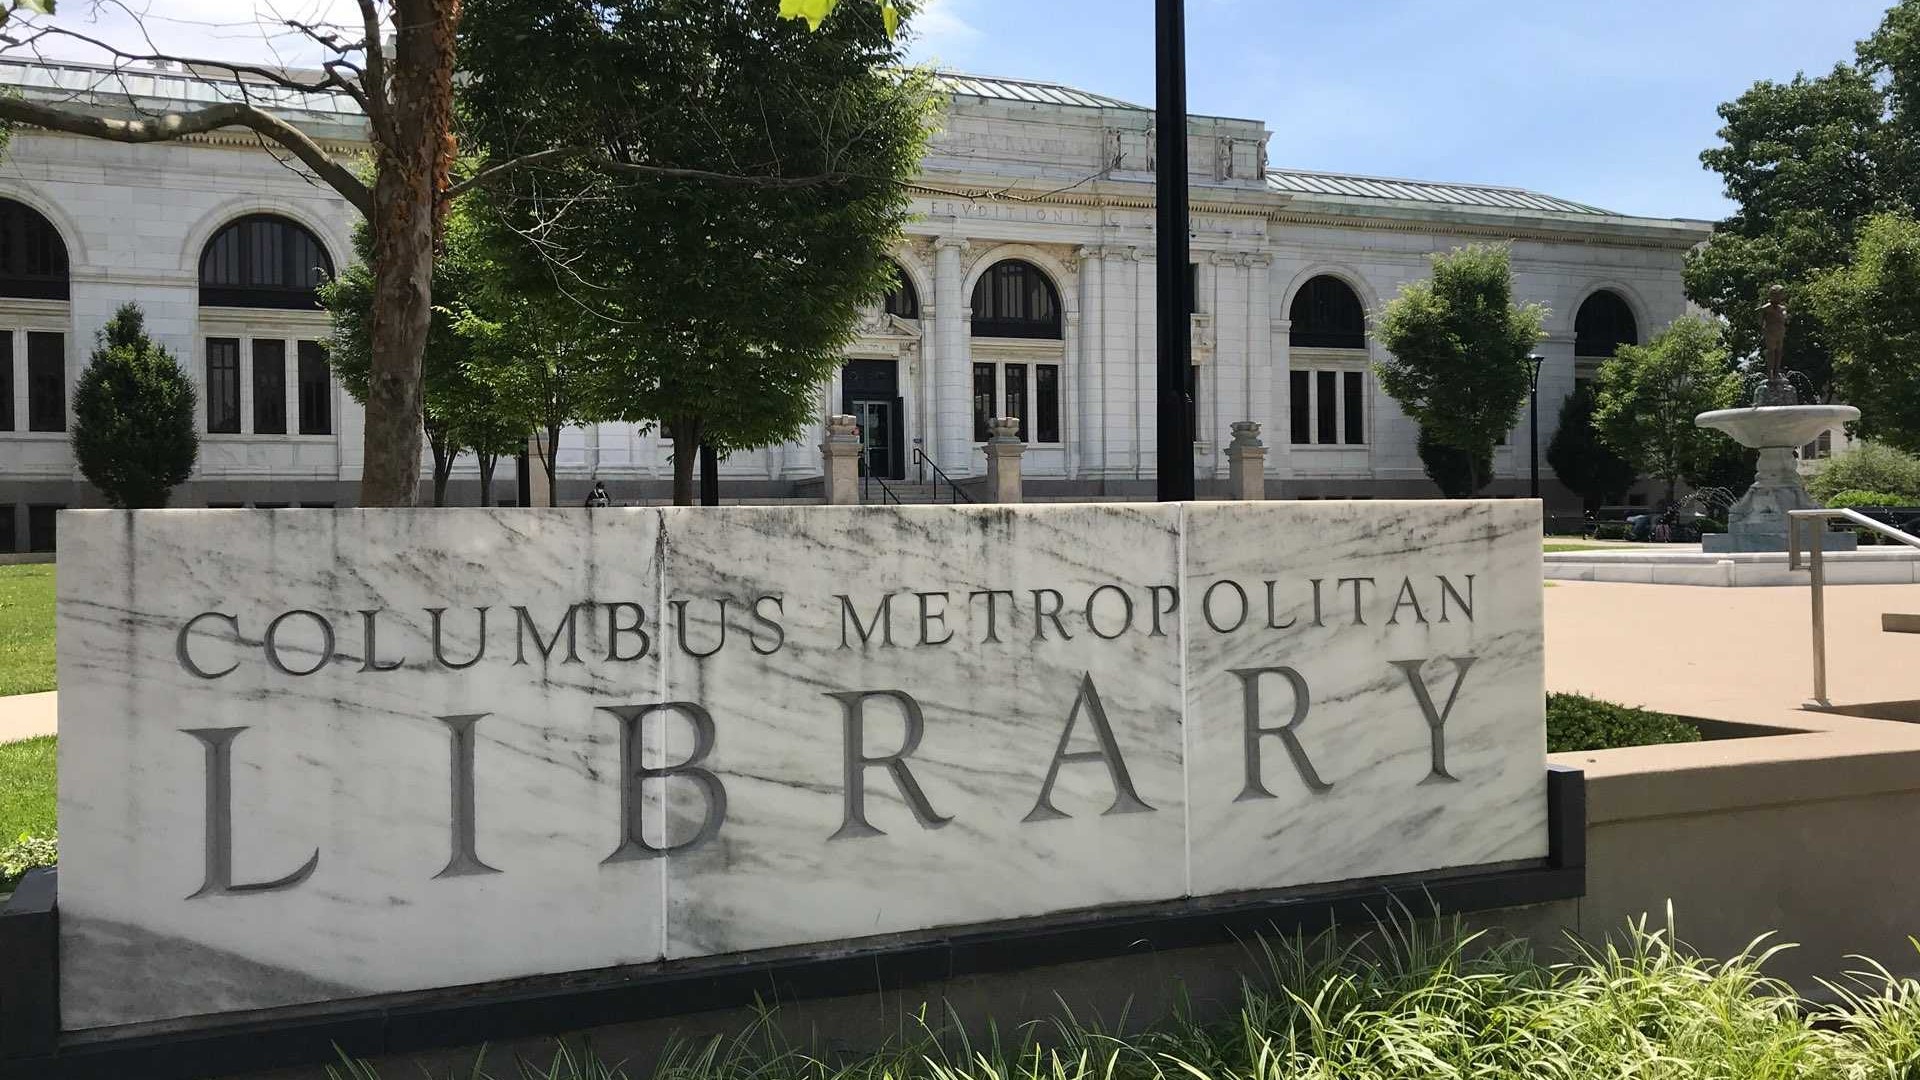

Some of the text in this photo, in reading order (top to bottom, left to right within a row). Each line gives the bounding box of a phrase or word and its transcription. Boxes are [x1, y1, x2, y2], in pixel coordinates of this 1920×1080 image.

[176, 574, 1476, 679] COLUMBUS METROPOLITAN
[177, 656, 1480, 900] LIBRARY
